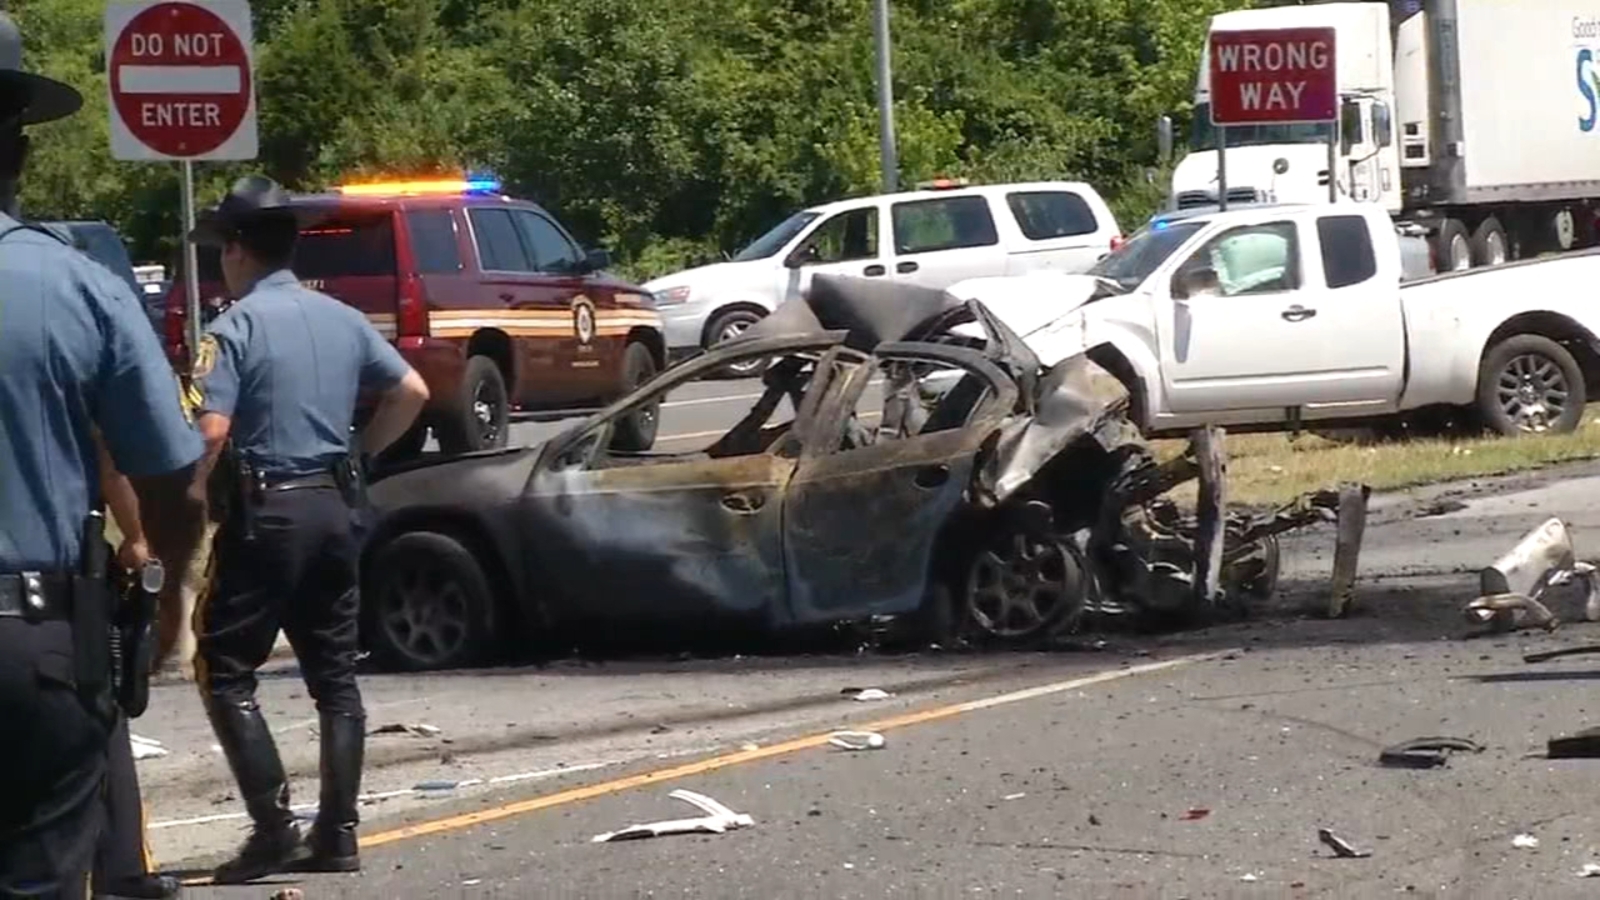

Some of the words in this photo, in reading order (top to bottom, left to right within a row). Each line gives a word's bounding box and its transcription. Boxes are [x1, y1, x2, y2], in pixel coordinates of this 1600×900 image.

[131, 33, 163, 56] DO
[174, 33, 223, 56] NOT
[1217, 41, 1328, 72] WRONG
[1240, 80, 1306, 110] WAY
[1576, 48, 1600, 132] S
[141, 103, 221, 126] ENTER
